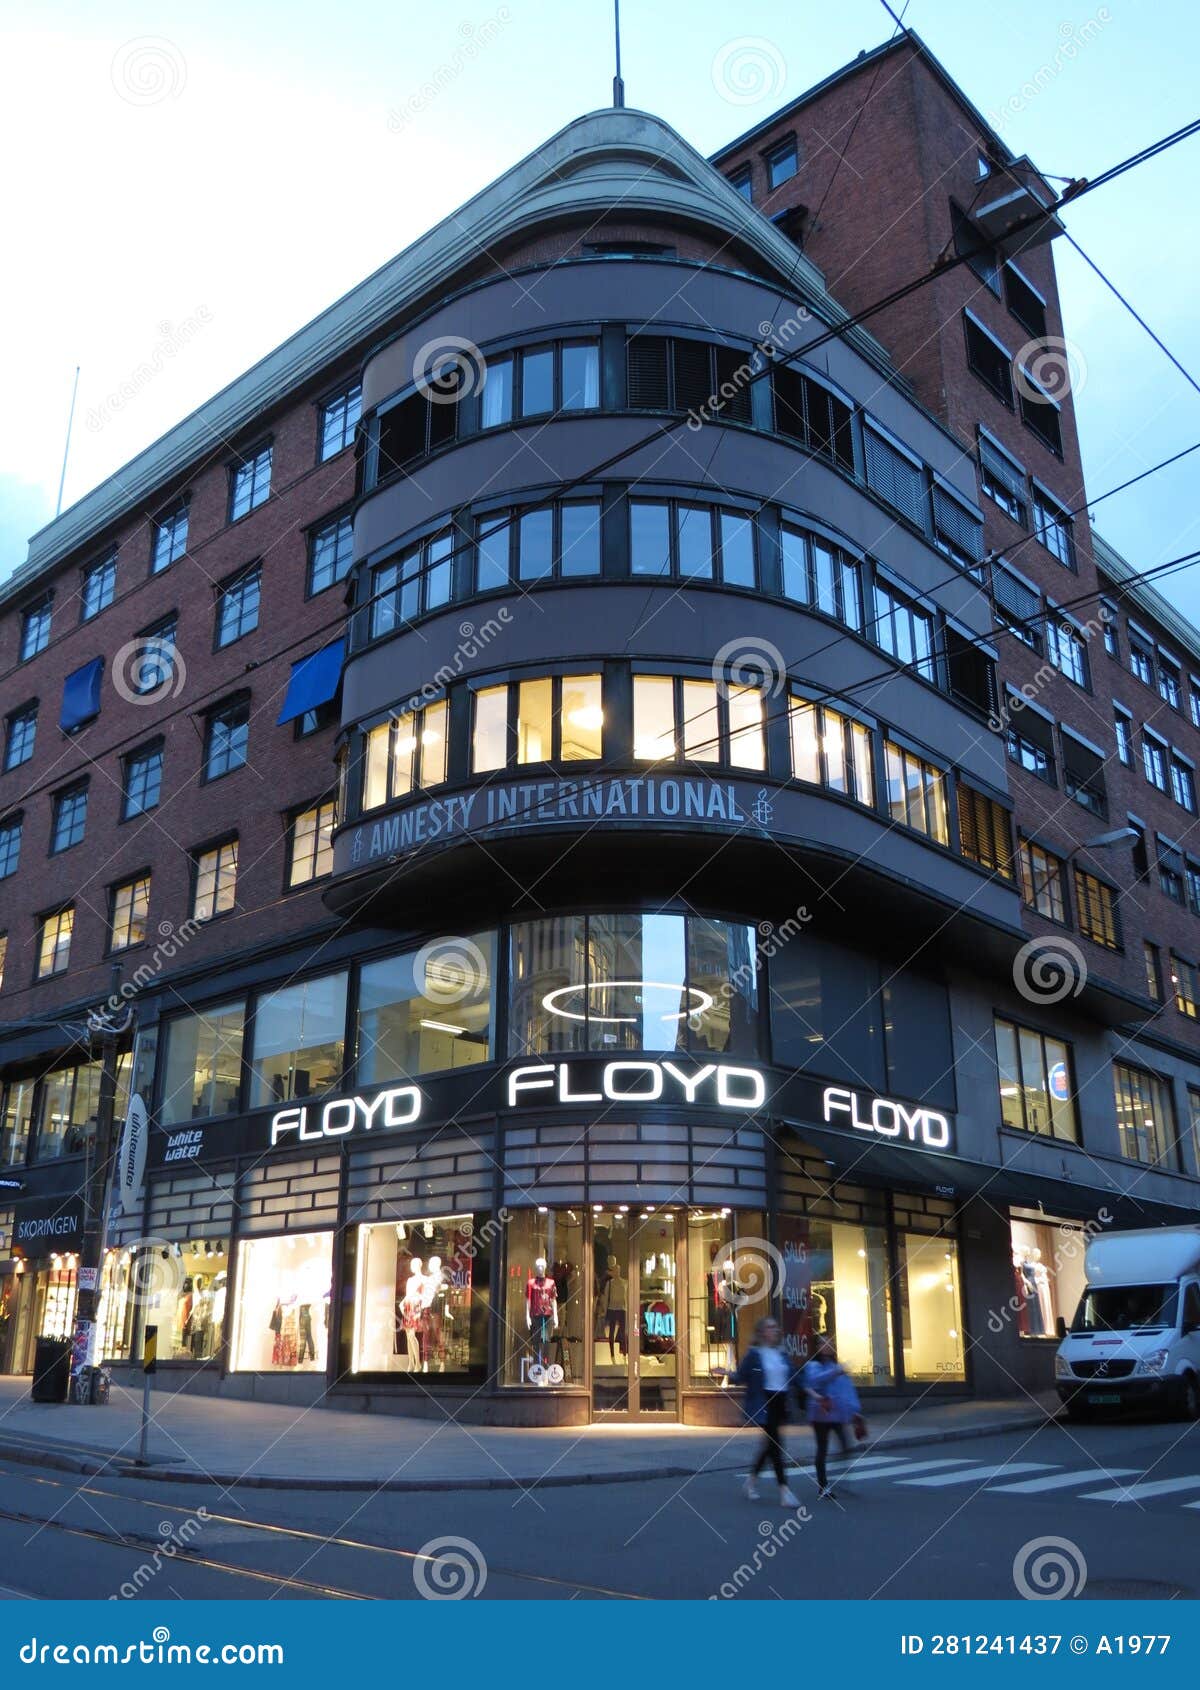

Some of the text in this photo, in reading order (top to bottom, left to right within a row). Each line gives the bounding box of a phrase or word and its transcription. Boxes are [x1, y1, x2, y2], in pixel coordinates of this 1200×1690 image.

[369, 779, 745, 858] AMNESTY INTERNATIONAL
[508, 1061, 766, 1108] FLOYD
[271, 1085, 422, 1145] FLOYD
[822, 1087, 951, 1148] FLOYD
[167, 1130, 203, 1147] white
[164, 1144, 204, 1162] water
[18, 1215, 78, 1239] SKORINGEN
[784, 1240, 807, 1264] SALG
[450, 1270, 472, 1289] SALG
[785, 1287, 808, 1310] SALG
[785, 1333, 809, 1357] SALG
[935, 1361, 963, 1372] FLOYD
